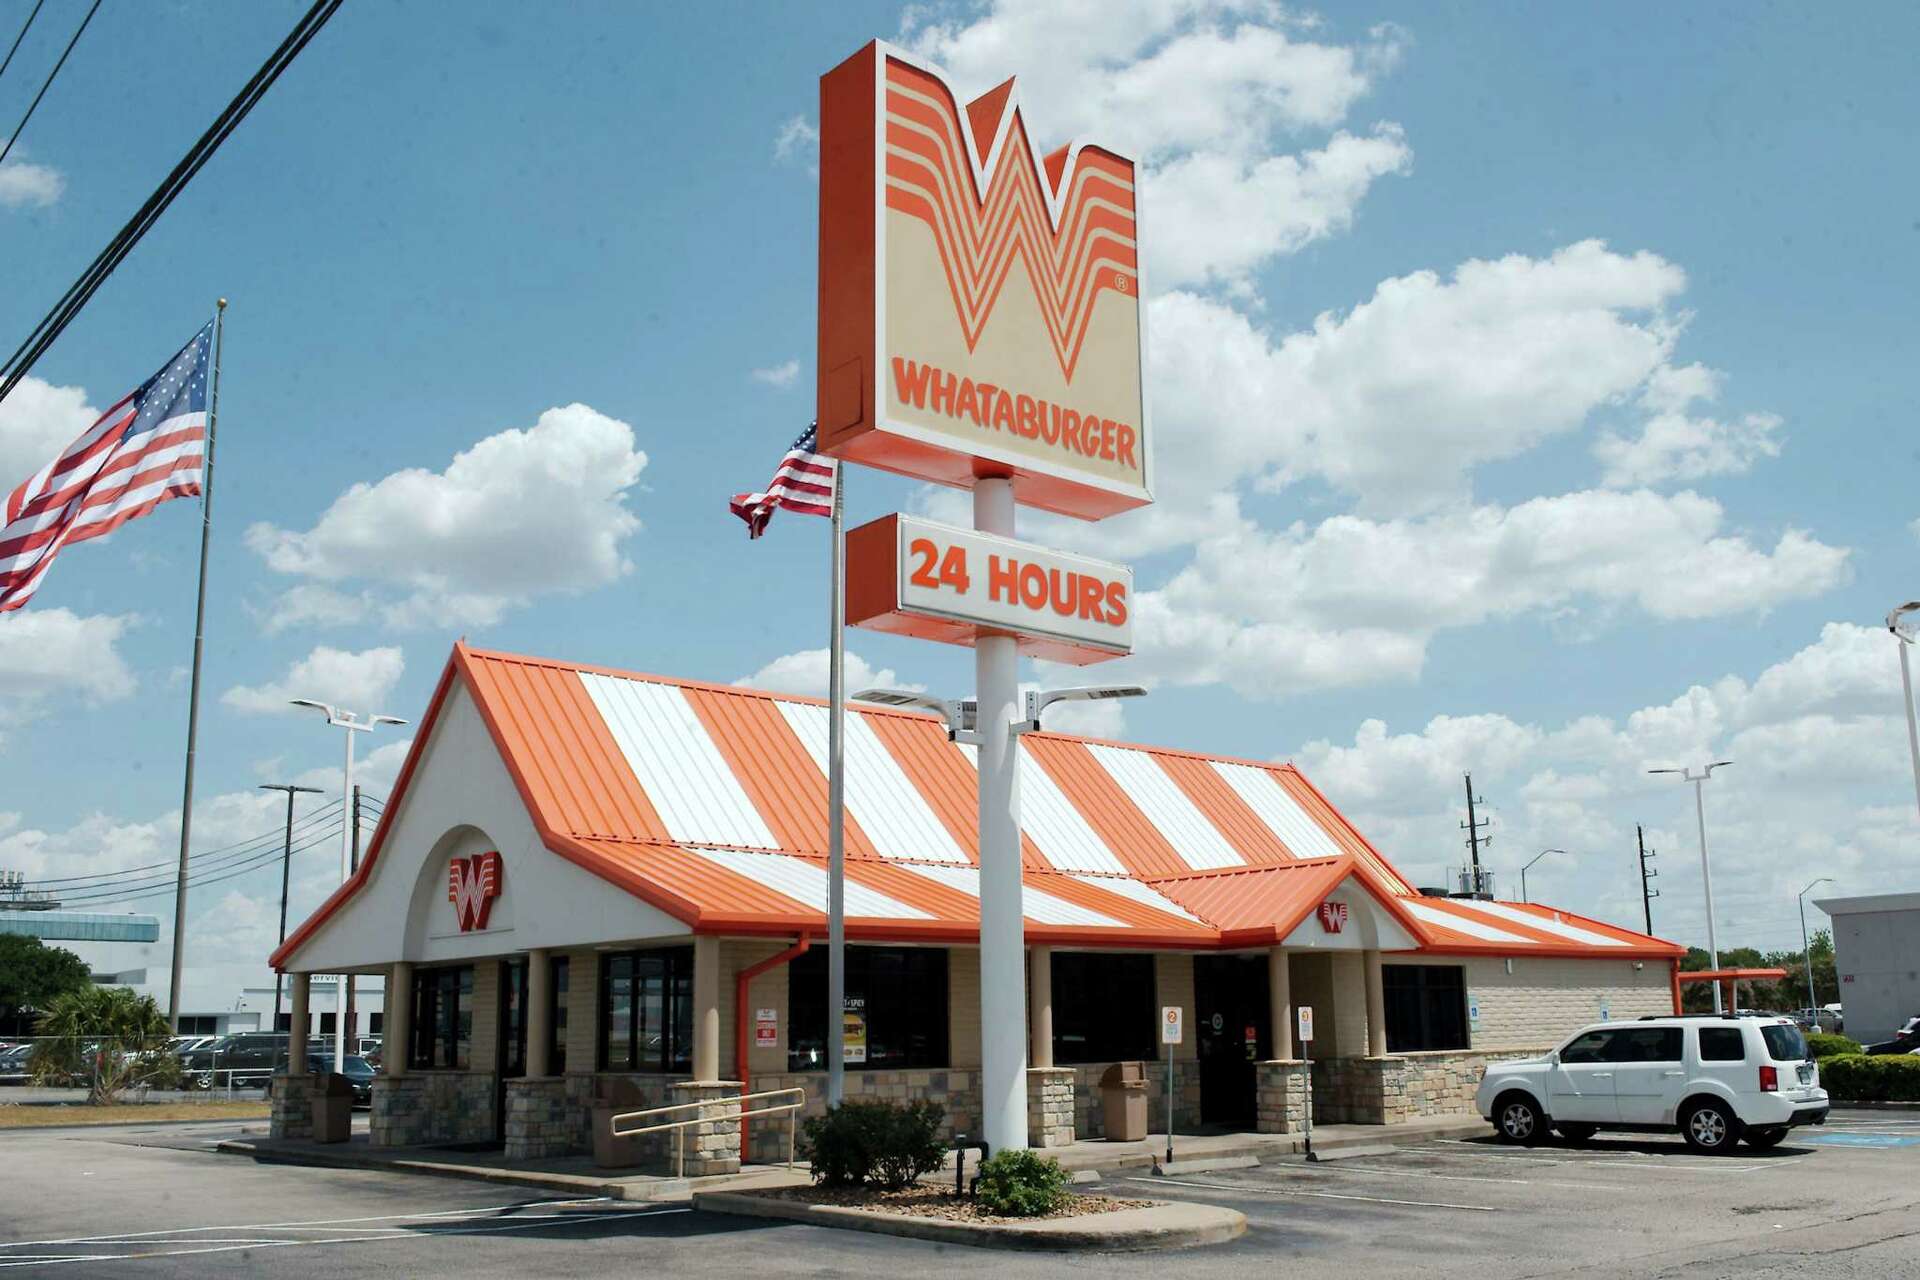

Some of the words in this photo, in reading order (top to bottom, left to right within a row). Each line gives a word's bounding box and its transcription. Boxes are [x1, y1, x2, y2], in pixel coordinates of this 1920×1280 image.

[892, 357, 1136, 470] WHATABURGER
[910, 538, 970, 594] 24
[988, 554, 1127, 627] HOURS
